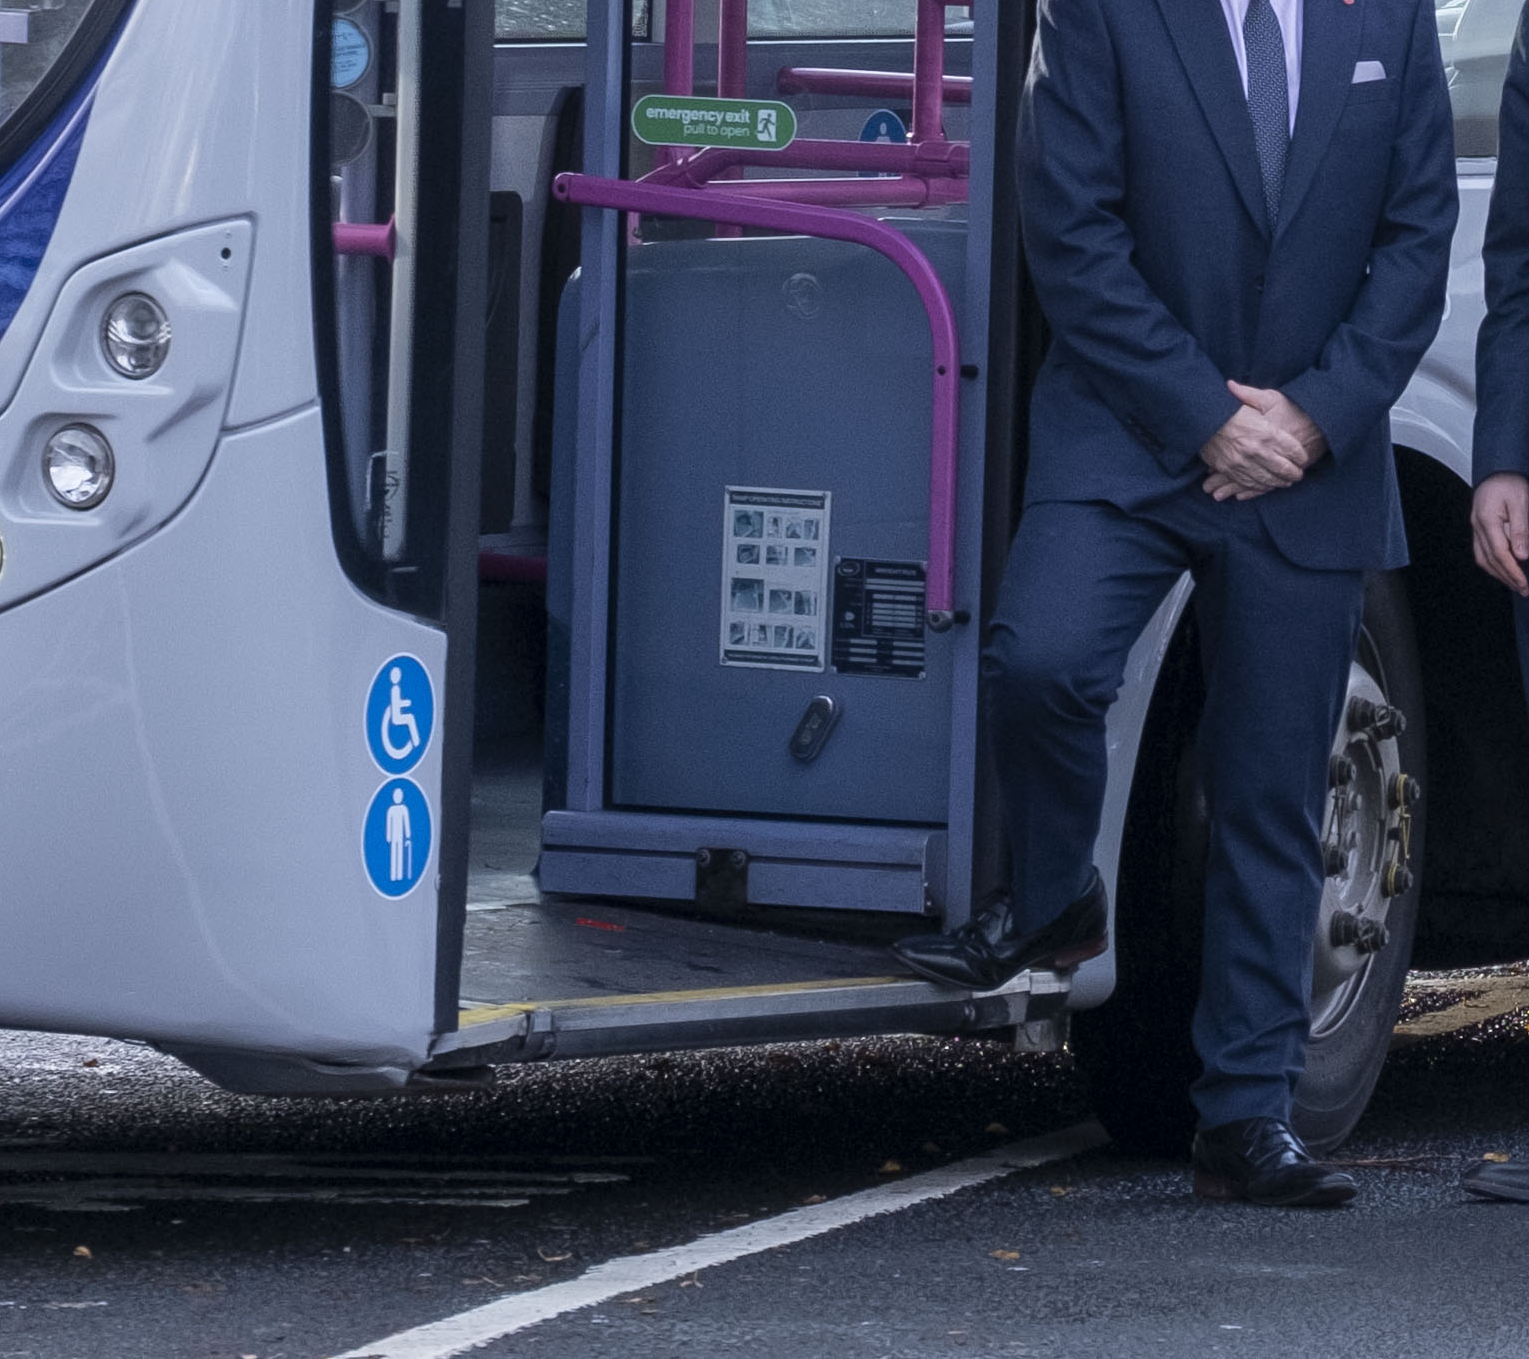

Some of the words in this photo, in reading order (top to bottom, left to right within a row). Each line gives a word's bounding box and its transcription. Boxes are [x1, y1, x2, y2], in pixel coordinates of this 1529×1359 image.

[646, 107, 724, 125] emergency
[725, 108, 751, 124] exit
[683, 123, 705, 137] pull
[707, 124, 719, 136] to
[720, 127, 750, 139] open
